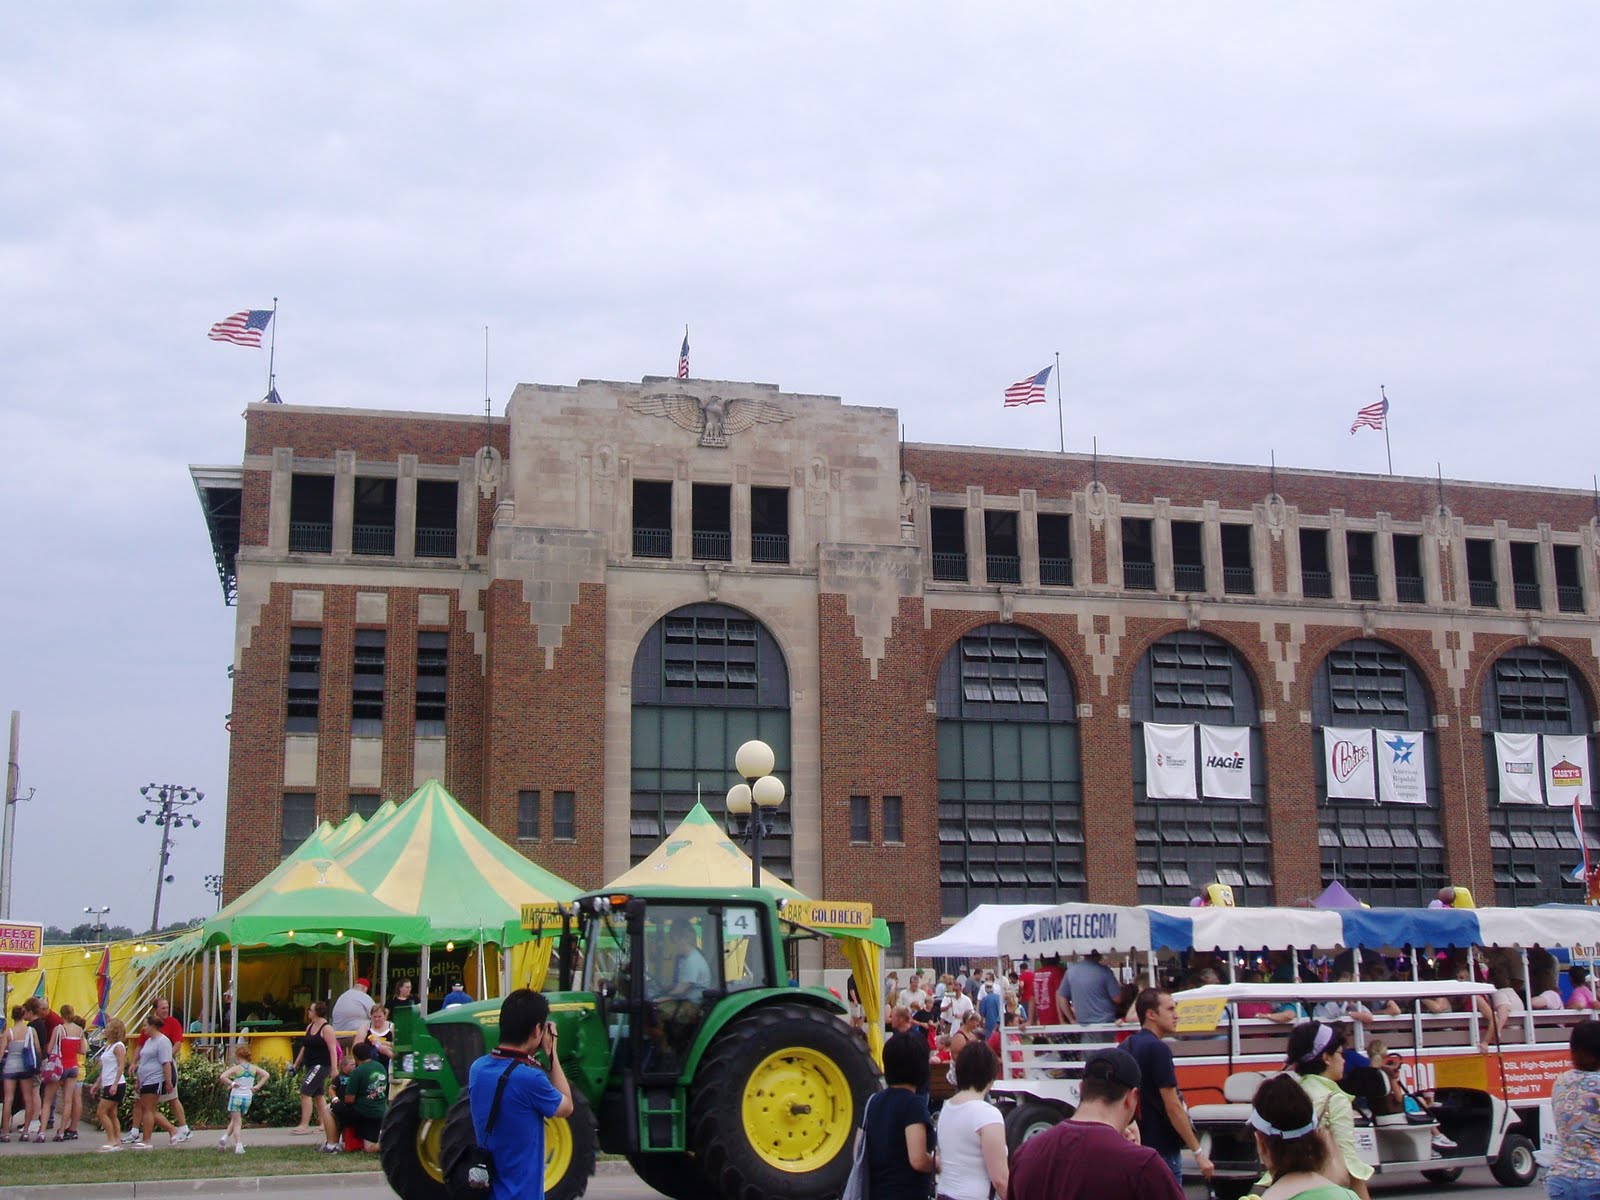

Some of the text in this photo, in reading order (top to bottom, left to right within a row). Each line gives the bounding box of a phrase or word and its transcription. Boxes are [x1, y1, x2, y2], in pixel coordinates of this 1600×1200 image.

[1207, 752, 1245, 769] HAGIE
[1554, 770, 1580, 778] CASEY'S
[788, 904, 802, 922] BAR
[812, 908, 837, 924] COLD
[838, 909, 862, 925] BEER
[735, 915, 749, 930] 4
[1039, 912, 1117, 942] IOWA TELECOM
[10, 939, 36, 950] STICK
[392, 962, 461, 978] merdith
[1503, 1062, 1519, 1070] DSL
[1520, 1060, 1563, 1071] High-Speed
[1504, 1073, 1543, 1082] Telephone
[1506, 1084, 1541, 1095] Digital TV
